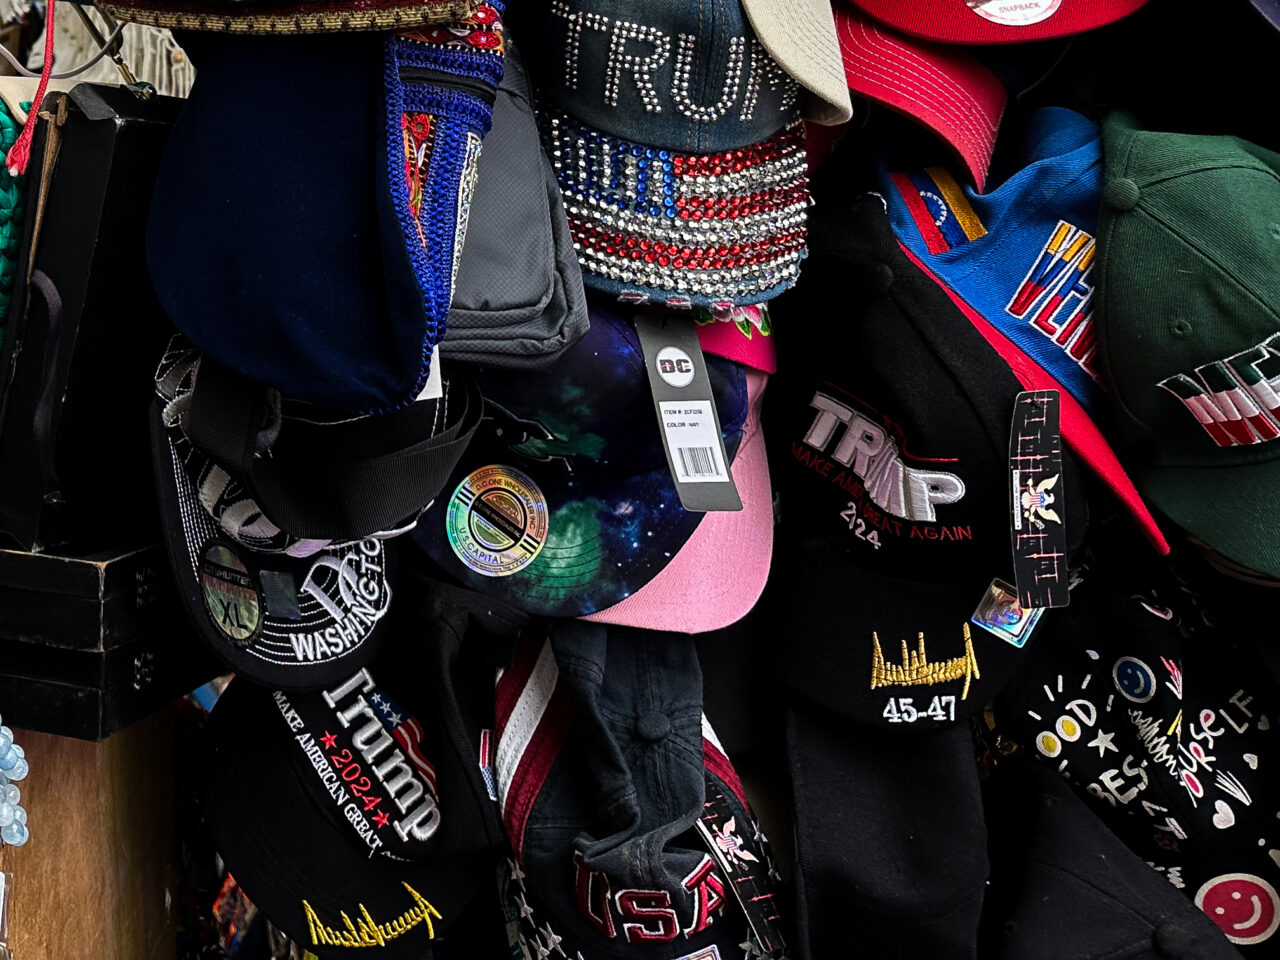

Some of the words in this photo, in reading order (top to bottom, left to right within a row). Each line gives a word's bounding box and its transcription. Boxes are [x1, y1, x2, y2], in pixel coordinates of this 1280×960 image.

[998, 1, 1041, 14] SNAPBACK
[551, 0, 800, 123] TRUM
[659, 358, 692, 374] DC
[909, 525, 973, 542] AGAIN
[219, 598, 248, 630] XL
[289, 537, 384, 662] WASHINGTO
[883, 695, 956, 723] 45-47
[272, 690, 305, 733] MAKE
[294, 732, 351, 807] AMERICAN
[343, 803, 384, 849] GREAT
[322, 667, 441, 843] Trump
[330, 748, 383, 812] 2024
[573, 848, 729, 944] USA
